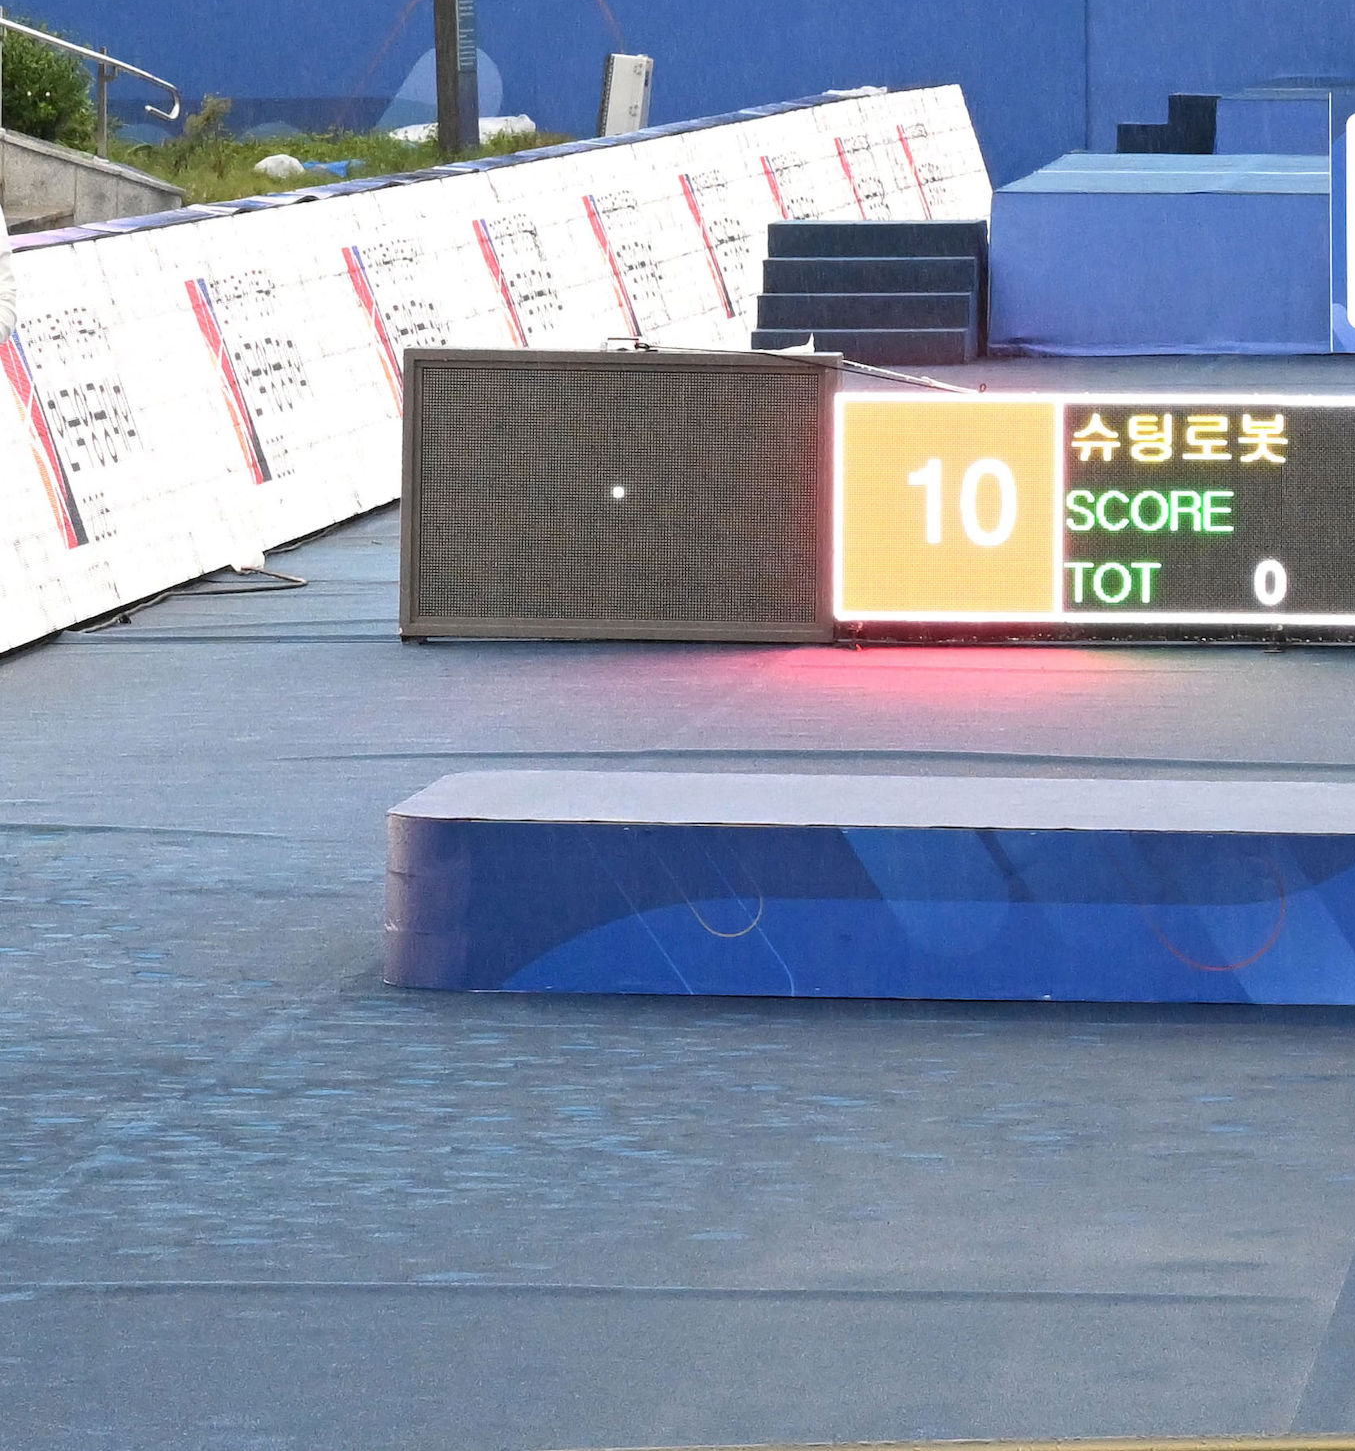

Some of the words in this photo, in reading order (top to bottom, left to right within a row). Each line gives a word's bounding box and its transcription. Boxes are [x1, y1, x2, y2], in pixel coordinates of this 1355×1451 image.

[1070, 413, 1289, 463] 슈팅로봇
[908, 458, 1017, 546] 10
[1066, 490, 1235, 533] SCORE
[1064, 560, 1161, 604] TOT
[1253, 559, 1288, 606] 0
